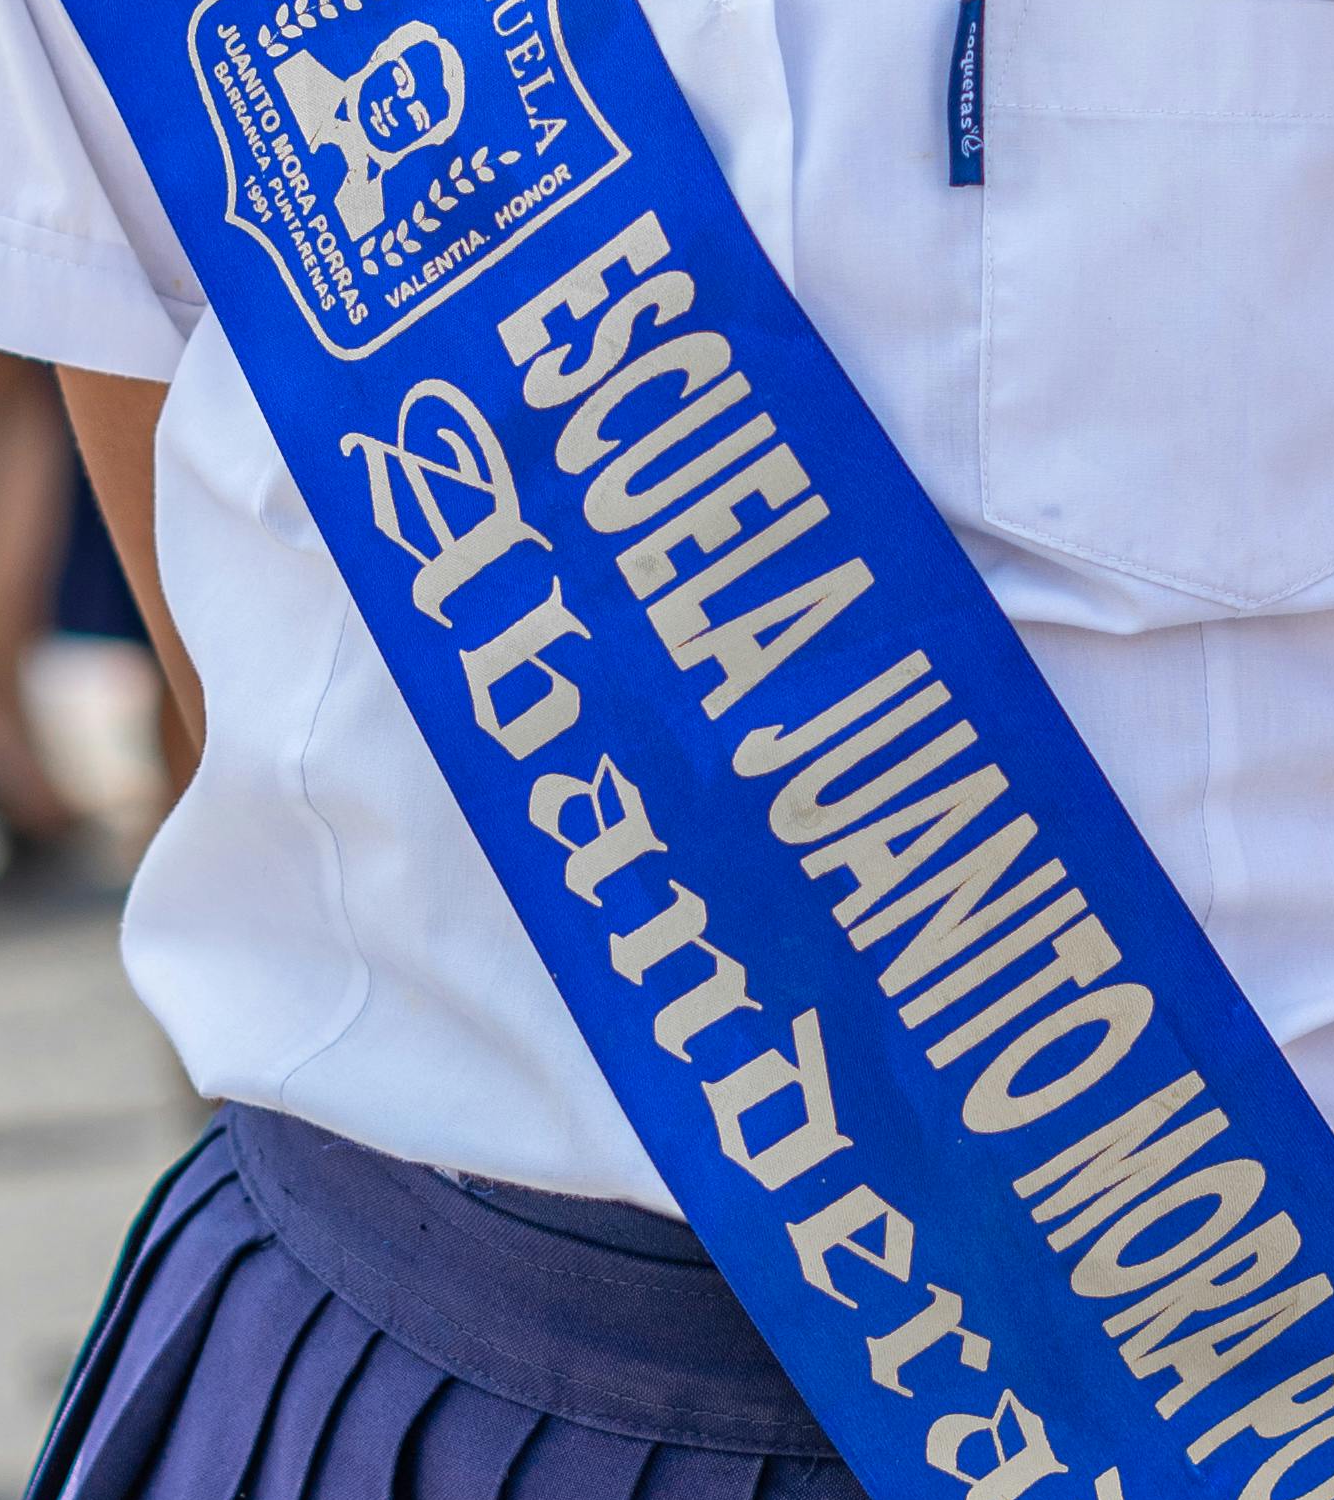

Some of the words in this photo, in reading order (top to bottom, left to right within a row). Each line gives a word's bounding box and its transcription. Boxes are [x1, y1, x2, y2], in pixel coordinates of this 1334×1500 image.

[959, 21, 977, 130] coquetas
[217, 24, 281, 133] JUANITO
[271, 133, 317, 216] MORA
[308, 214, 369, 326] PORRAS
[243, 175, 273, 223] 1991
[494, 163, 572, 230] HONOR
[269, 177, 336, 312] PUNTARENAS
[496, 209, 875, 721] ESCUELA
[731, 649, 1154, 1134] JUANITO
[1012, 1070, 1334, 1421] MORA
